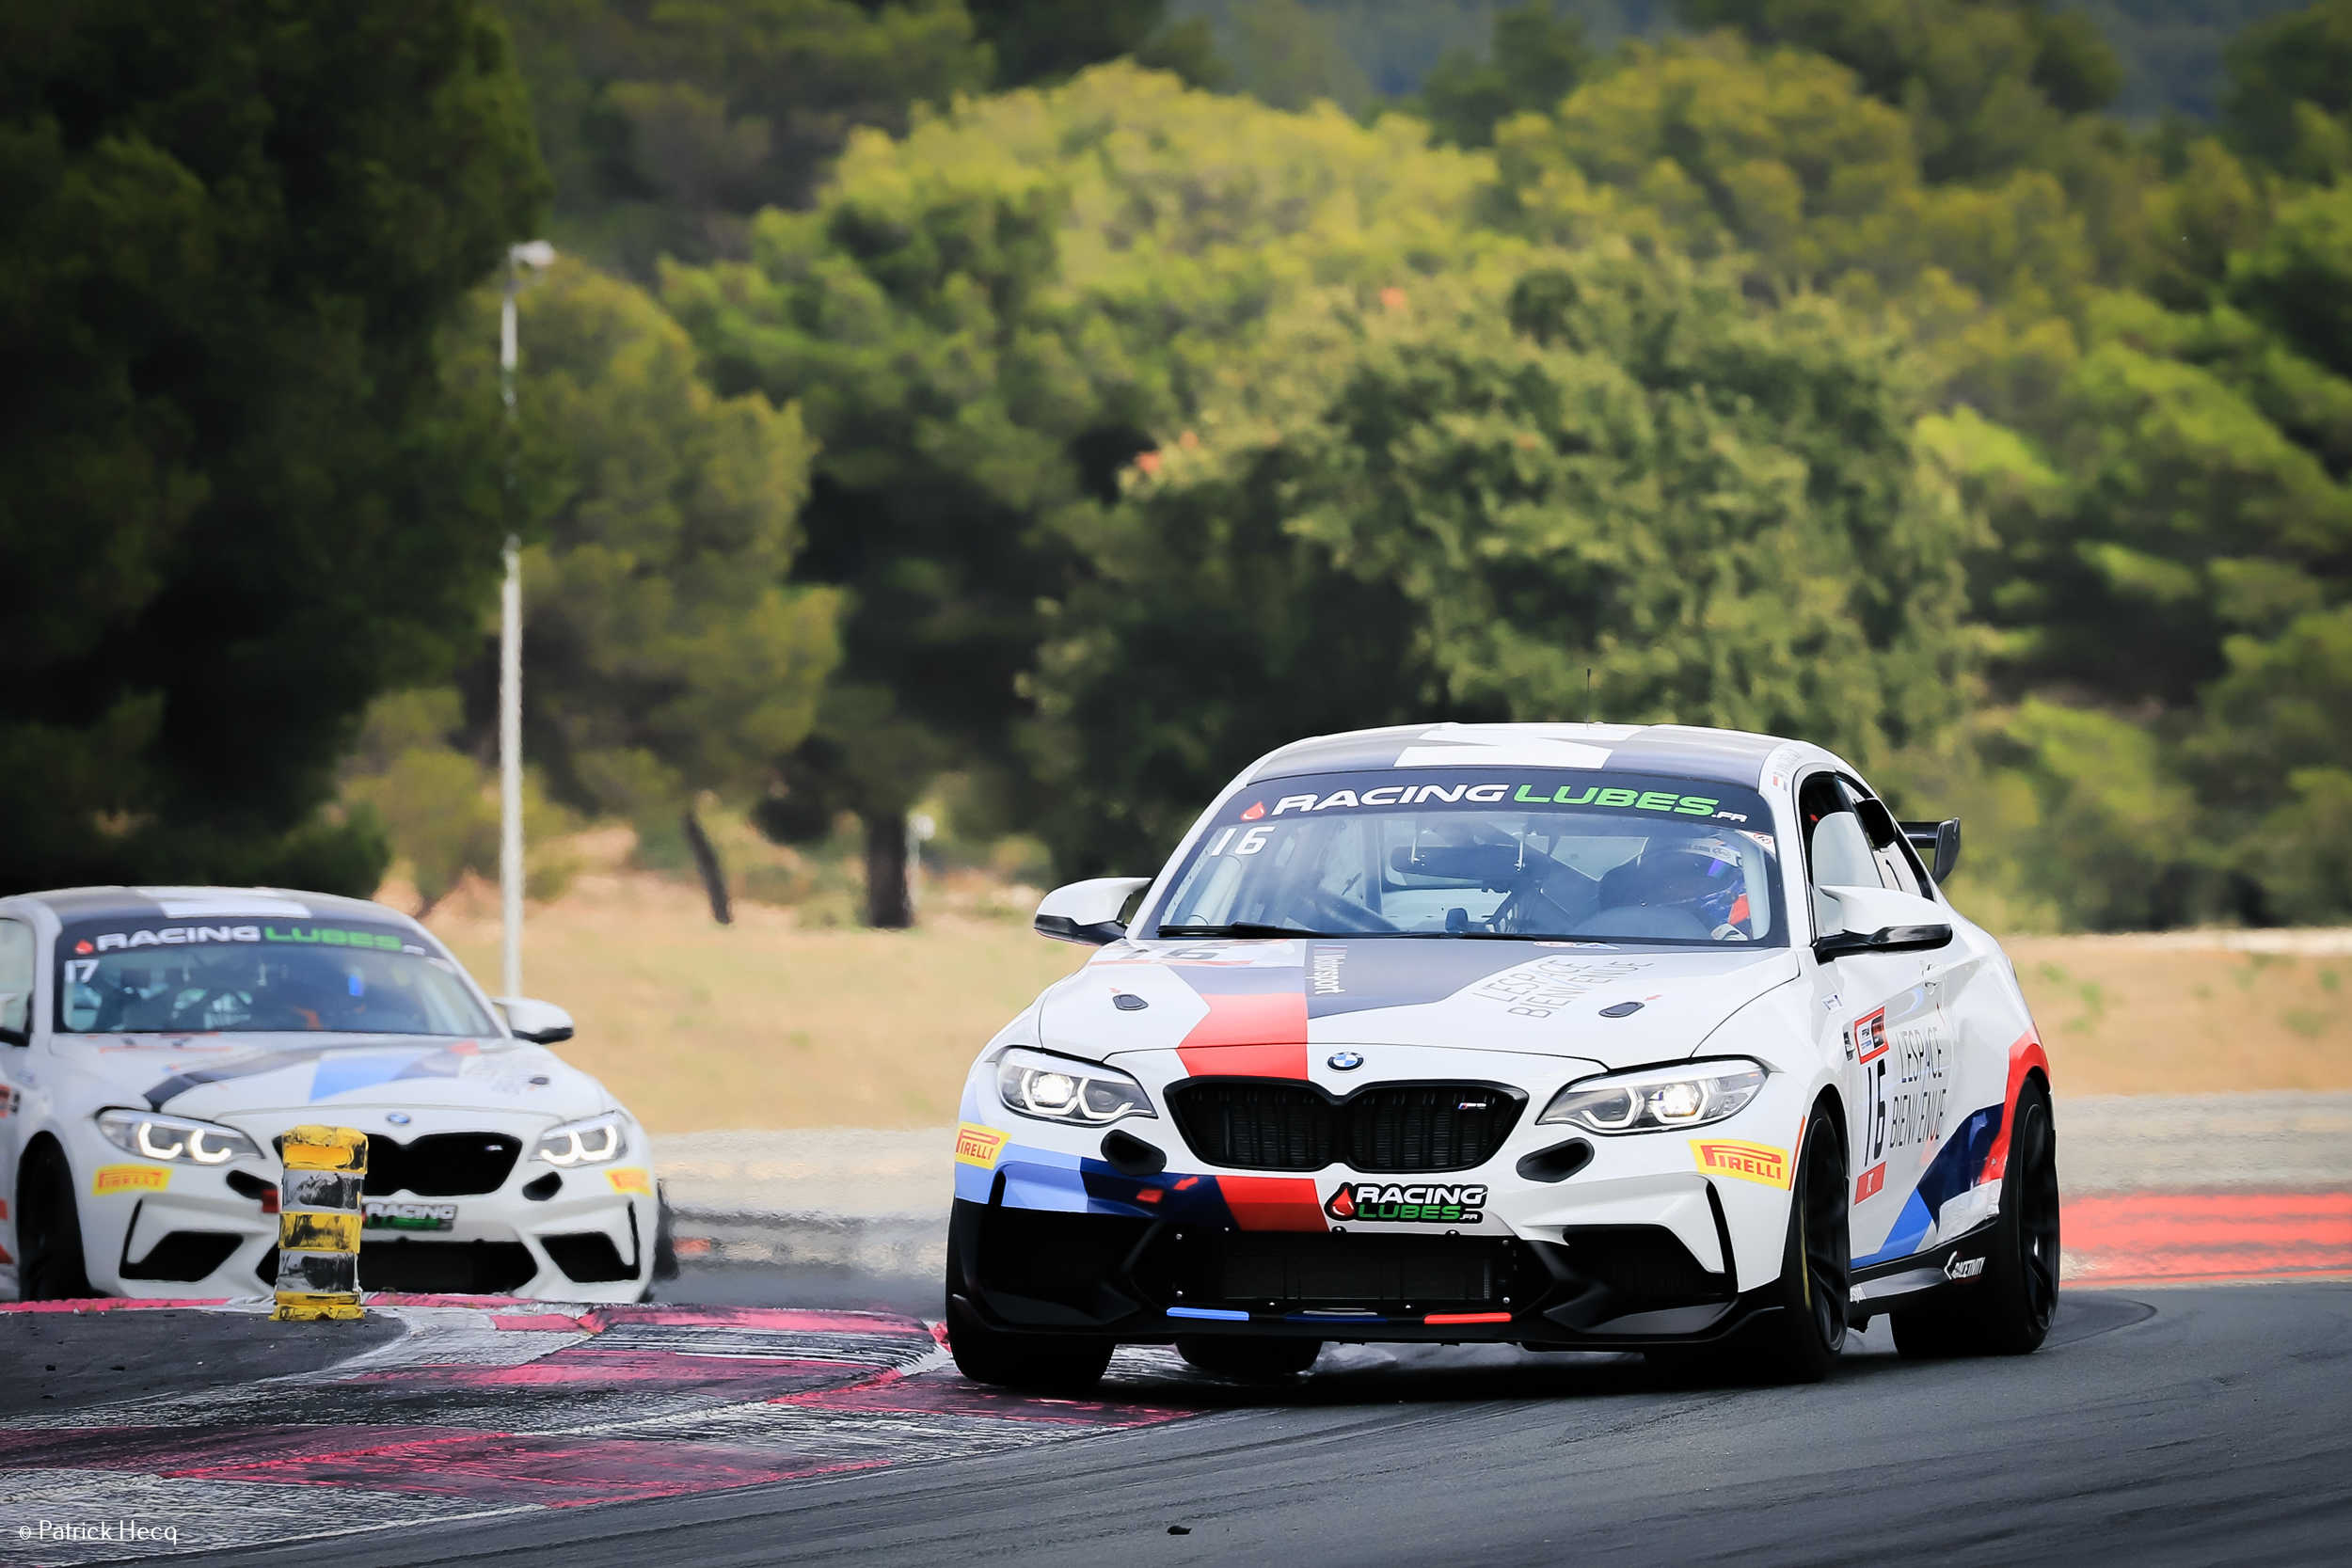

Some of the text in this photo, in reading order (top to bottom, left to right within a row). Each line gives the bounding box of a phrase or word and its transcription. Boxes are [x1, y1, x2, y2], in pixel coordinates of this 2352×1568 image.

[1211, 827, 1277, 857] 16
[64, 958, 100, 983] 17
[1864, 1057, 1886, 1167] 16
[956, 1128, 1000, 1160] PIRELLI
[1700, 1145, 1782, 1180] PIRELLI
[1355, 1186, 1486, 1205] RACING
[1358, 1204, 1479, 1222] LUBES.FR
